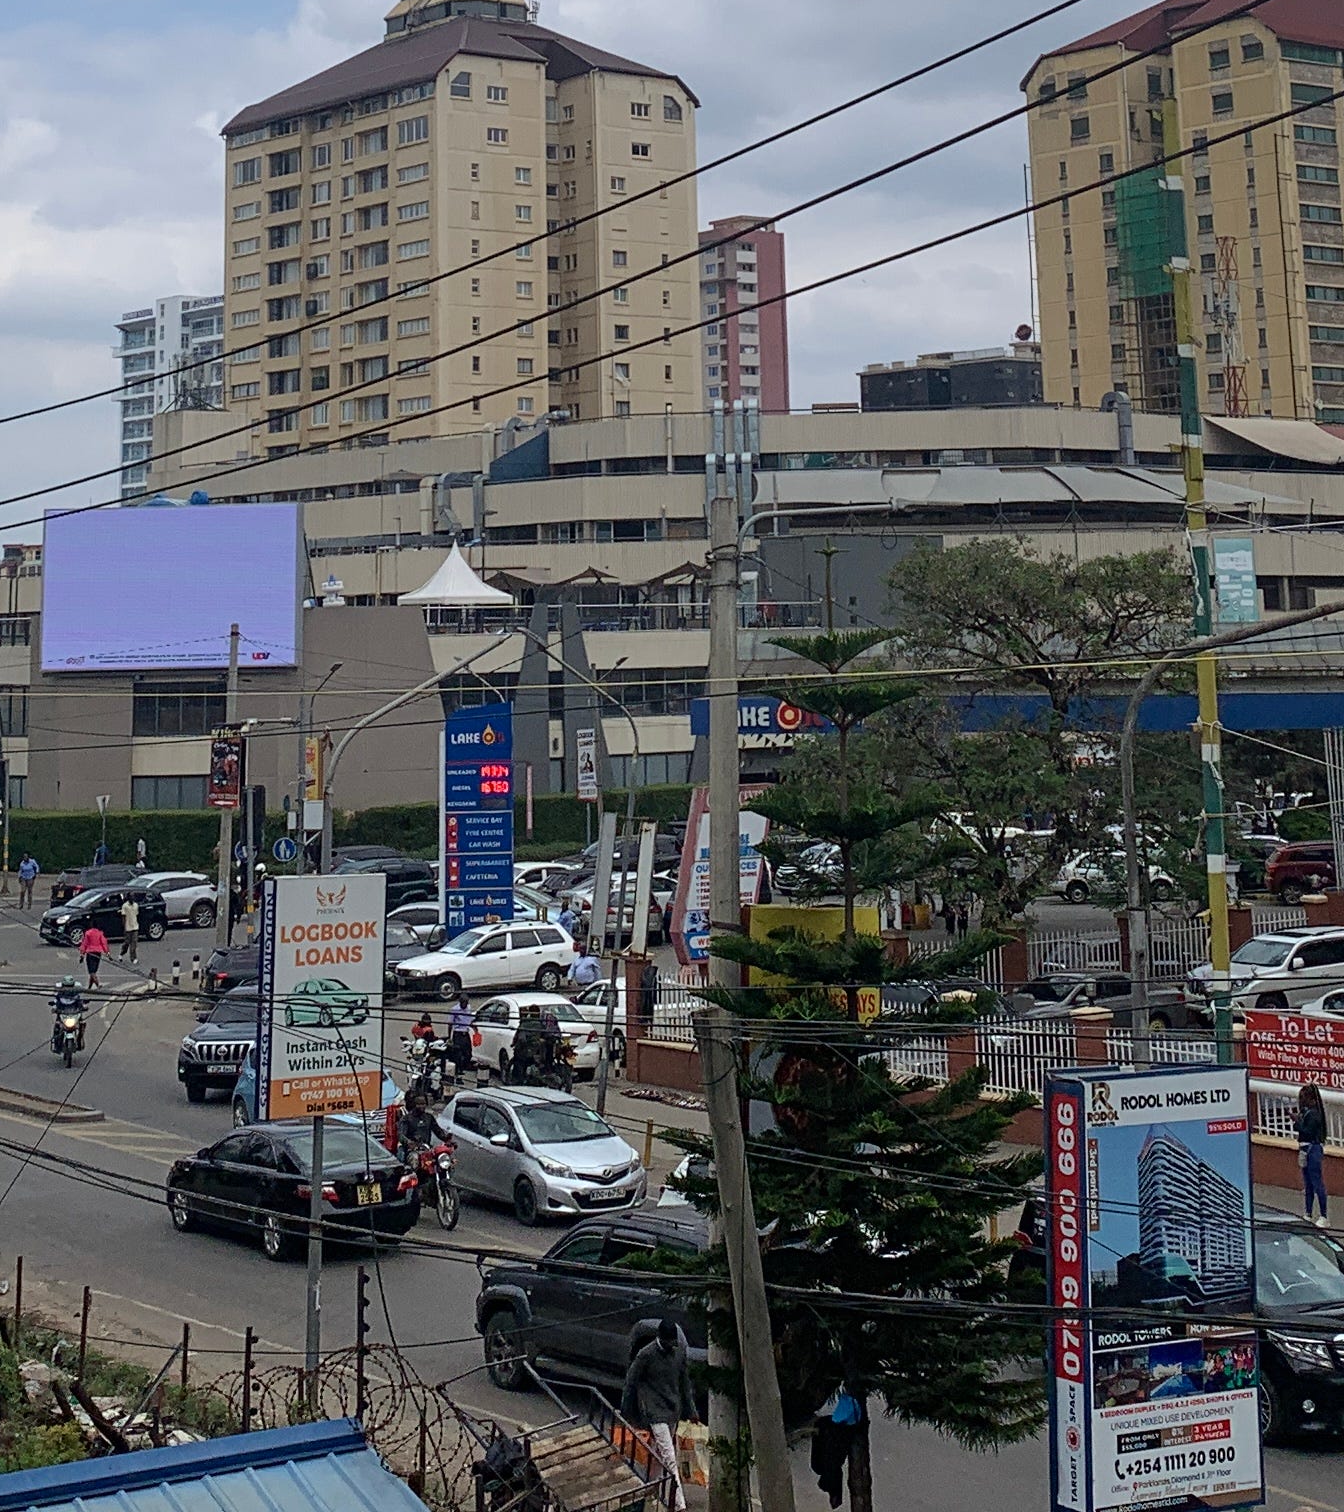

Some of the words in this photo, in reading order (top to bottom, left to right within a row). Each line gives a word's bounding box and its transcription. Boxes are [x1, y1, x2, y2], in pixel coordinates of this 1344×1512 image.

[451, 732, 480, 744] LAKE
[280, 920, 379, 944] LOGBOOK
[294, 945, 363, 967] LOANS
[1277, 1015, 1299, 1038] To
[1304, 1018, 1335, 1042] Let
[286, 1039, 332, 1055] Instant
[336, 1035, 367, 1050] Cash
[1250, 1031, 1299, 1053] Offices
[1302, 1044, 1326, 1055] From
[288, 1055, 333, 1071] Within
[335, 1052, 365, 1069] 2Hrs
[1258, 1049, 1276, 1060] With
[1277, 1052, 1297, 1064] Fibre
[1299, 1055, 1319, 1068] Optic
[292, 1079, 310, 1089] Call
[323, 1076, 370, 1087] WhatsApp
[1270, 1064, 1301, 1081] 0700
[1304, 1070, 1328, 1086] 325
[307, 1103, 325, 1112] Dial
[1121, 1094, 1163, 1110] RODOL
[1166, 1090, 1207, 1107] HOMES
[1210, 1089, 1230, 1103] LTD
[1087, 1110, 1119, 1122] RODOL
[1222, 1122, 1242, 1130] SOLD
[1057, 1101, 1076, 1176] 666
[1089, 1148, 1098, 1168] 3rd
[1059, 1188, 1078, 1263] 900
[1098, 1332, 1131, 1346] RODOL
[1068, 1384, 1076, 1423] SPACE
[1110, 1418, 1139, 1432] UNIQUE
[1140, 1416, 1164, 1427] MIXED
[1165, 1413, 1180, 1423] USE
[1181, 1406, 1235, 1422] DEVELOPMENT
[1201, 1423, 1224, 1432] YEAR
[1194, 1430, 1230, 1442] PAYMENT
[1126, 1456, 1161, 1477] +254
[1164, 1453, 1186, 1471] 1111
[1189, 1450, 1206, 1467] 20
[1209, 1445, 1236, 1465] 900
[1070, 1455, 1078, 1503] TARGET
[1171, 1473, 1200, 1485] Diamond
[1216, 1469, 1232, 1478] Floor
